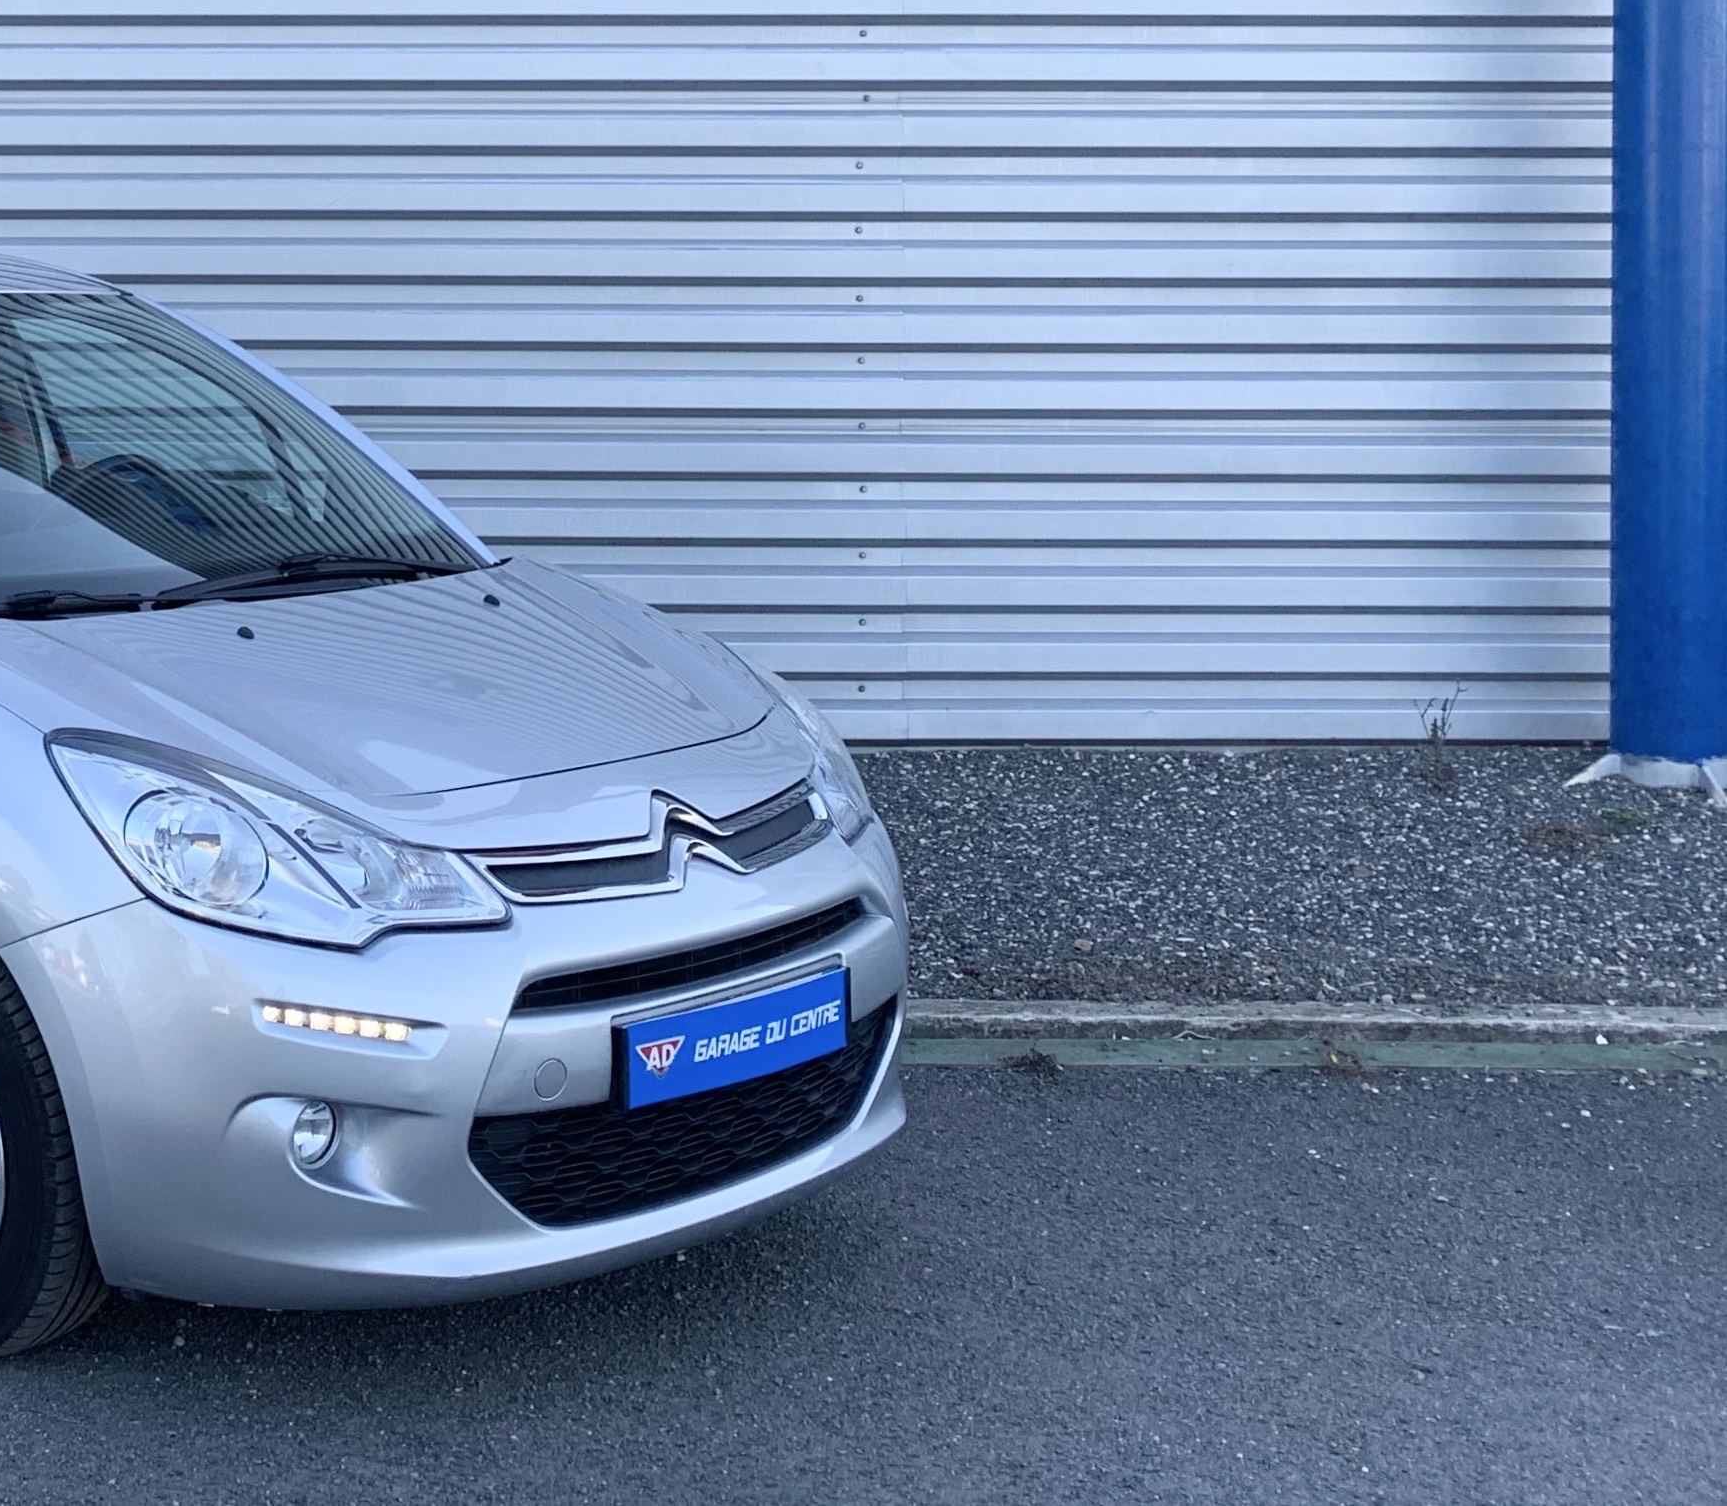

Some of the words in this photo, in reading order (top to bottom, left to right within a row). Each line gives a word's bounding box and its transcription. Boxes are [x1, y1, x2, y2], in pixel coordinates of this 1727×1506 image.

[695, 1026, 762, 1062] GARAGE
[765, 1018, 787, 1045] DU
[790, 1000, 841, 1036] CENTRE
[647, 1043, 675, 1071] AD
